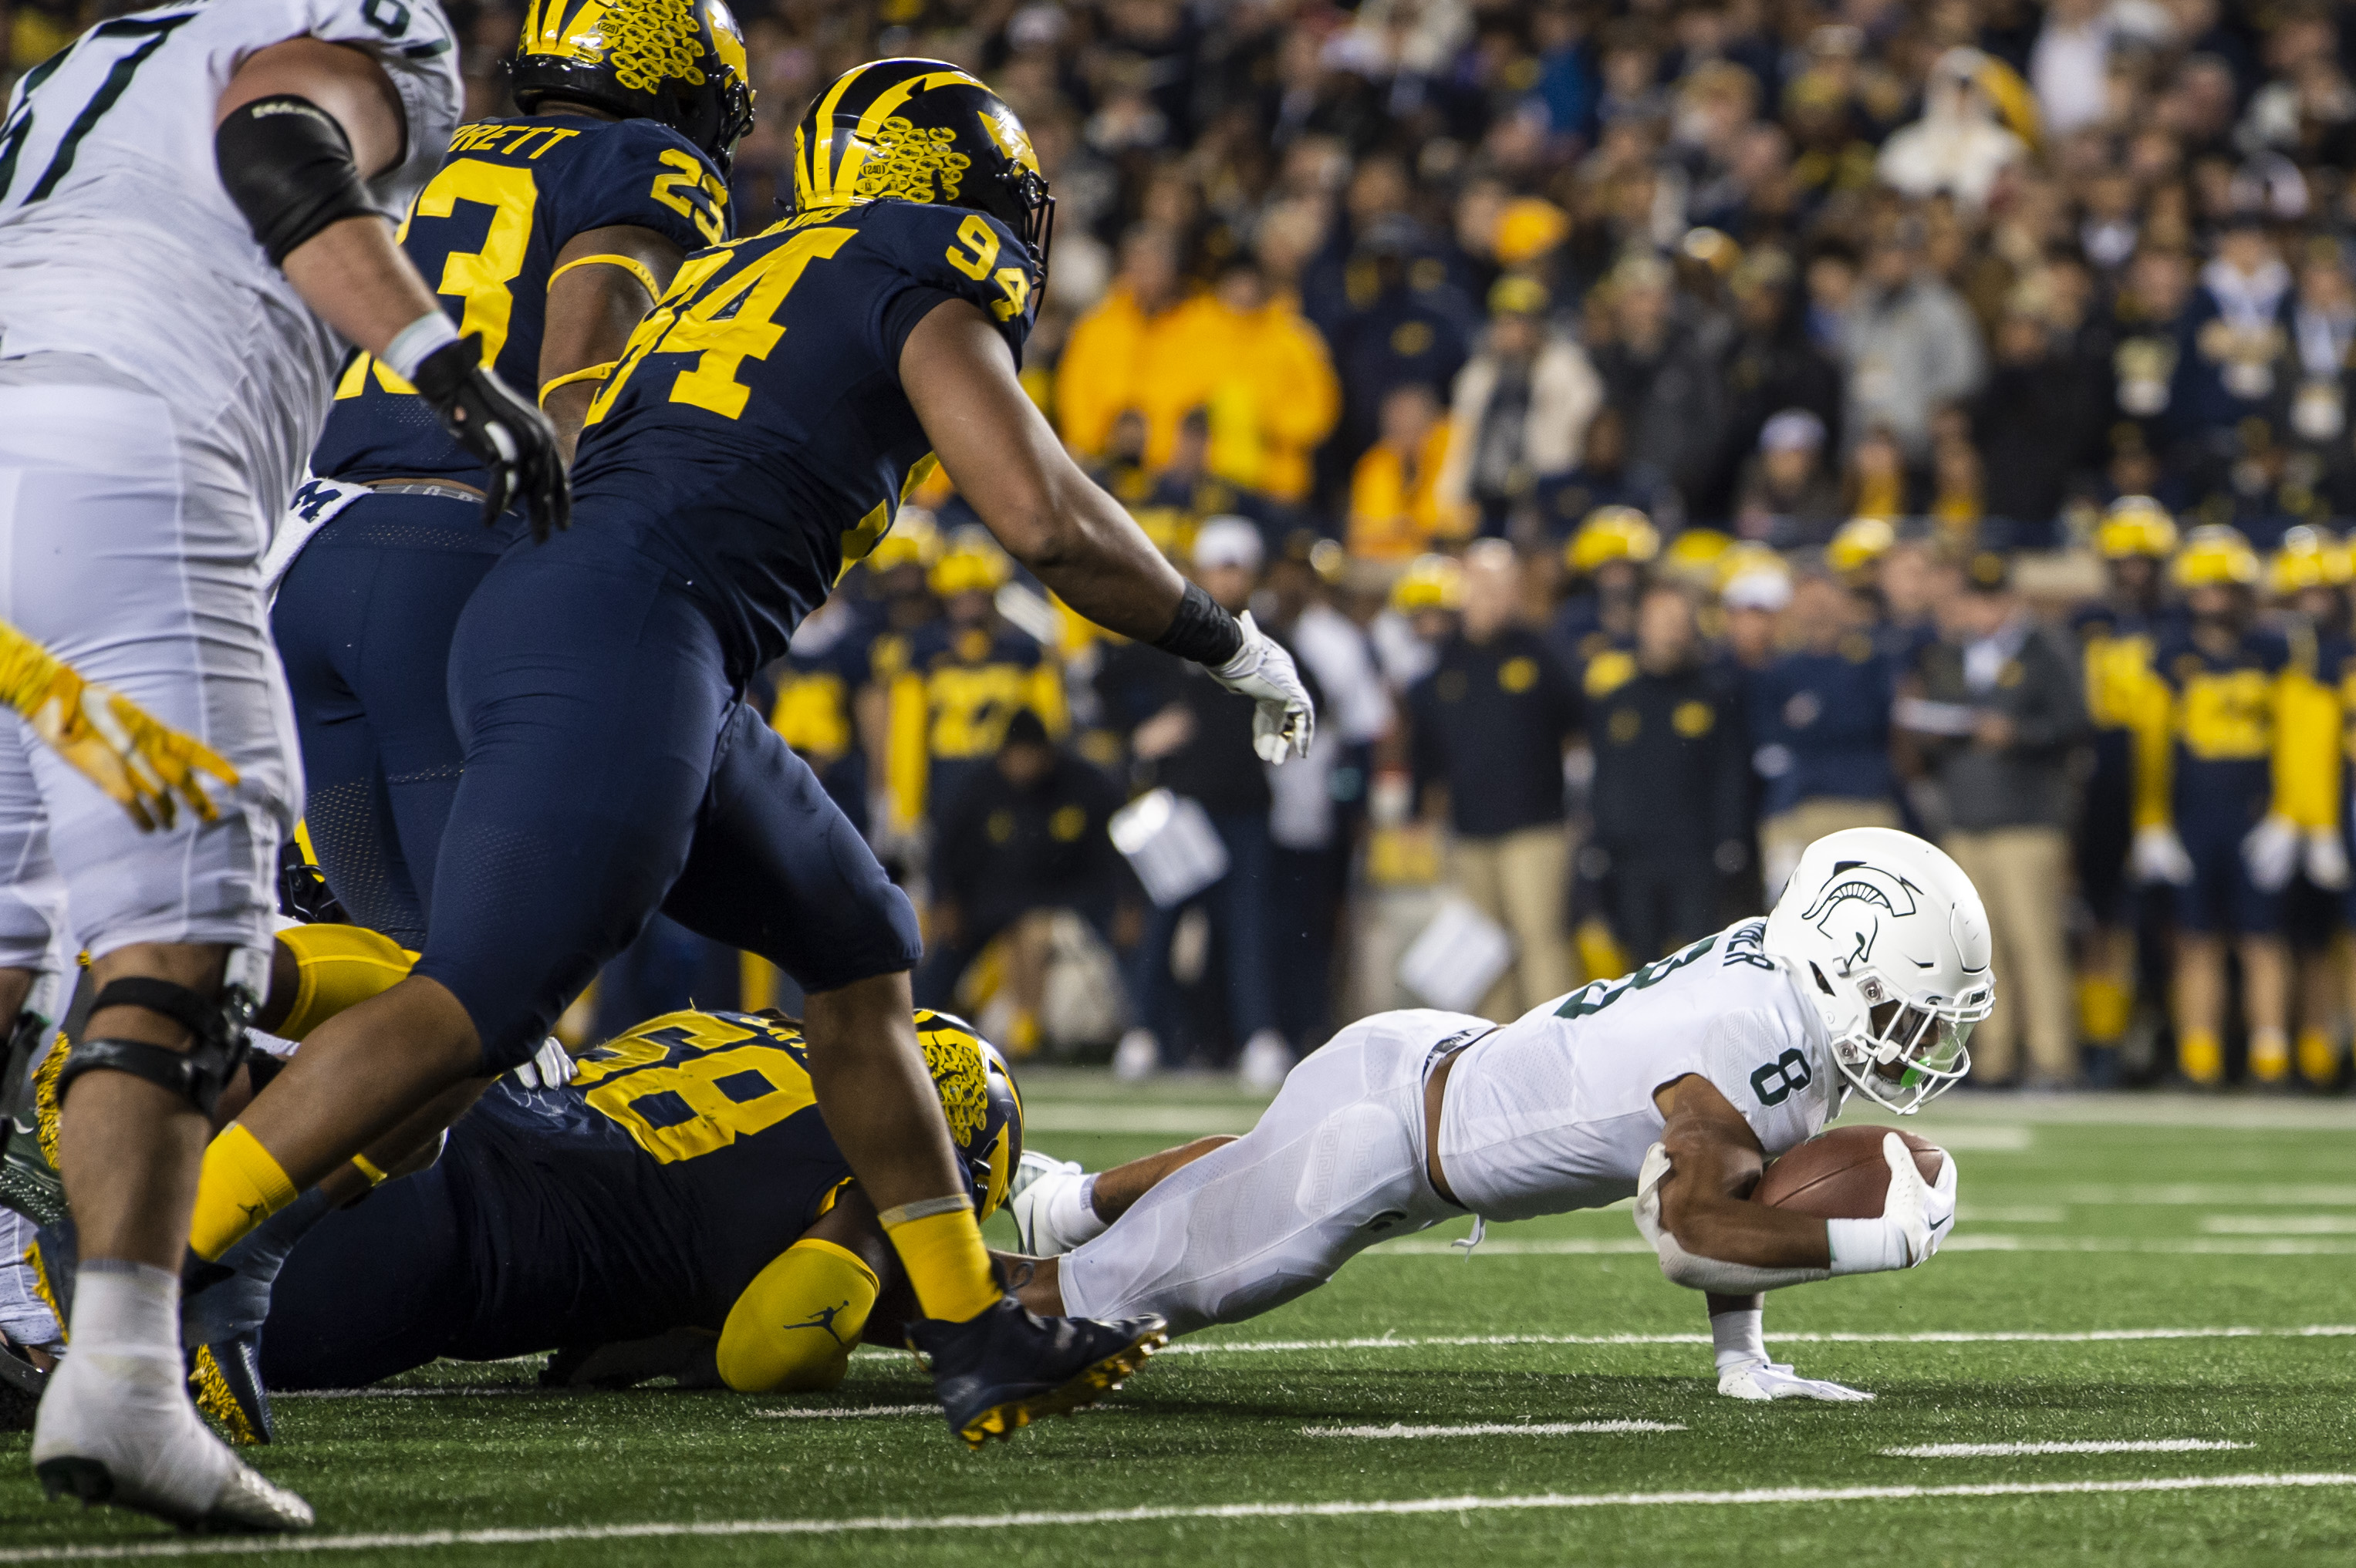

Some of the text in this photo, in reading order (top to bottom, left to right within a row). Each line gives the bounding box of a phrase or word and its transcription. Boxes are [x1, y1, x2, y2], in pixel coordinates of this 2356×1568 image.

[650, 148, 727, 247] 23
[945, 214, 1031, 322] 94
[584, 227, 859, 427] 94
[1552, 935, 1721, 1020] 8
[569, 1009, 818, 1165] 58
[1749, 1047, 1812, 1107] 8
